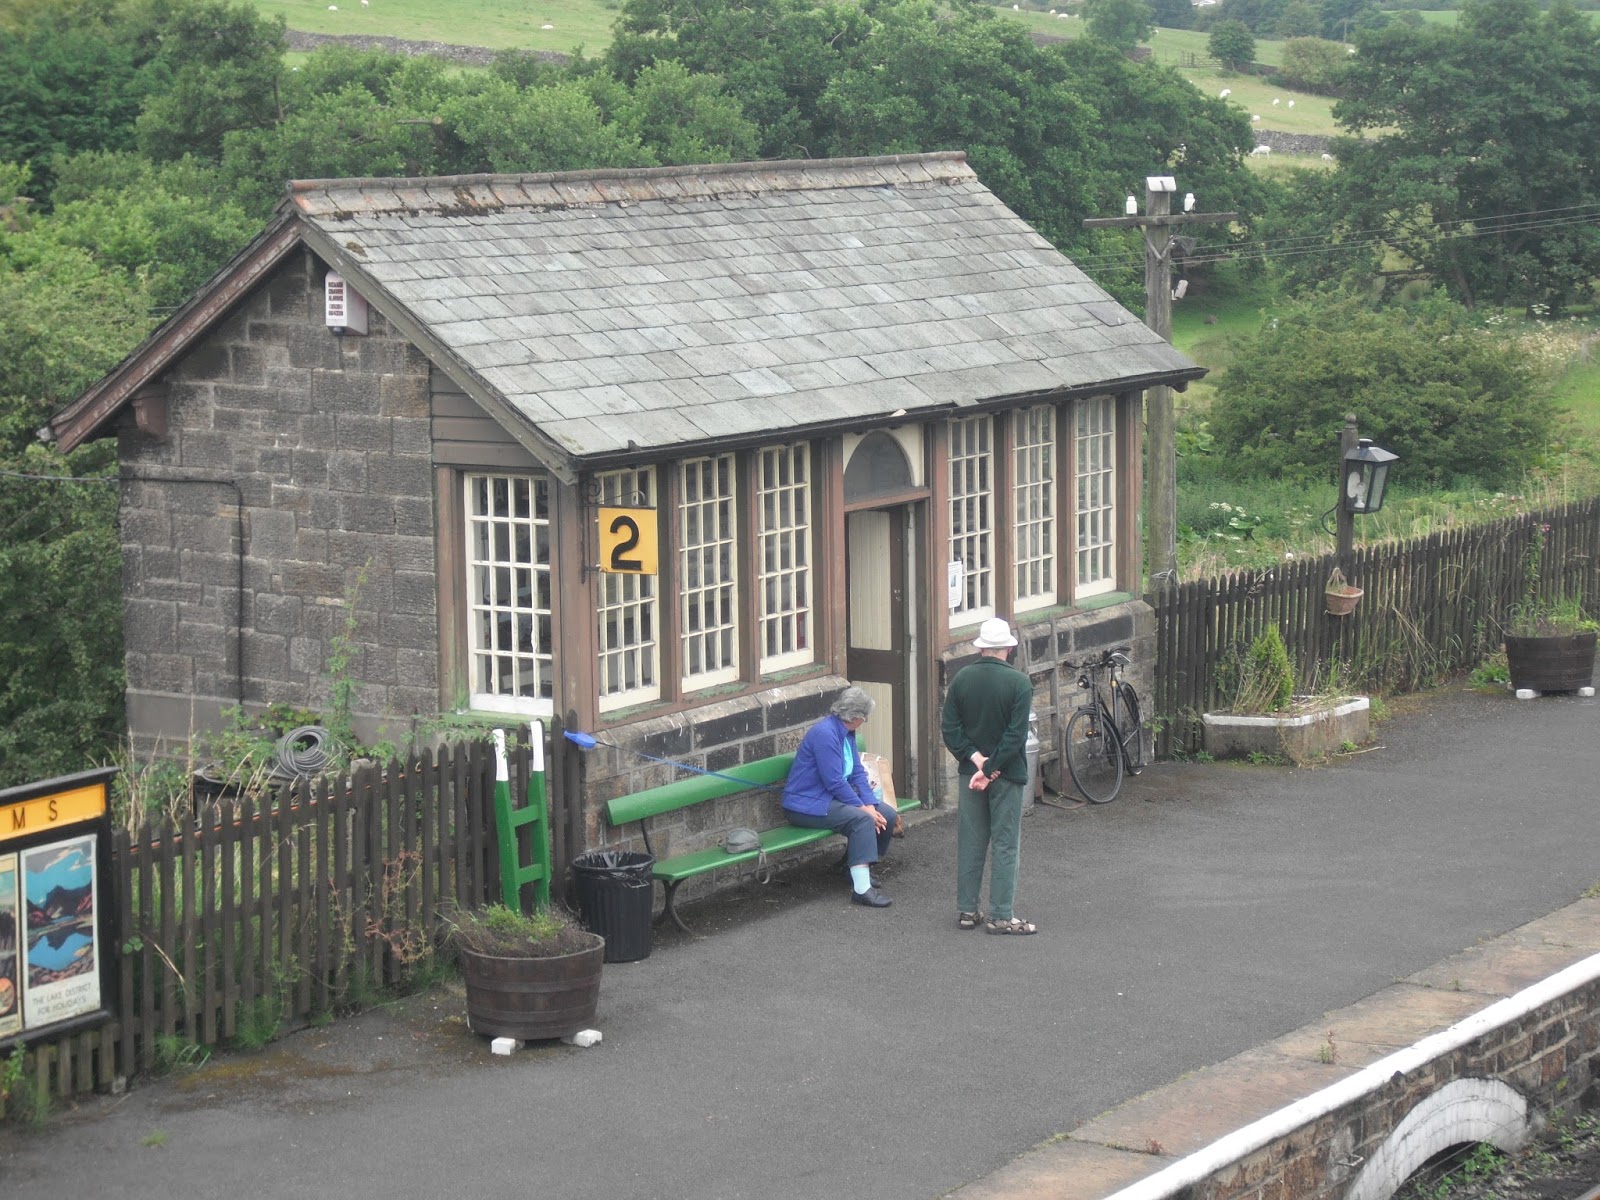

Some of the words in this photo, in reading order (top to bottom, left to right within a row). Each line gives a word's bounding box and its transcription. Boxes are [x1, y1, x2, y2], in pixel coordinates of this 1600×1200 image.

[610, 515, 642, 571] 2
[33, 995, 44, 1005] THE
[47, 991, 62, 1002] LAKE
[65, 983, 91, 997] DISTRICT
[37, 1006, 50, 1016] FOR
